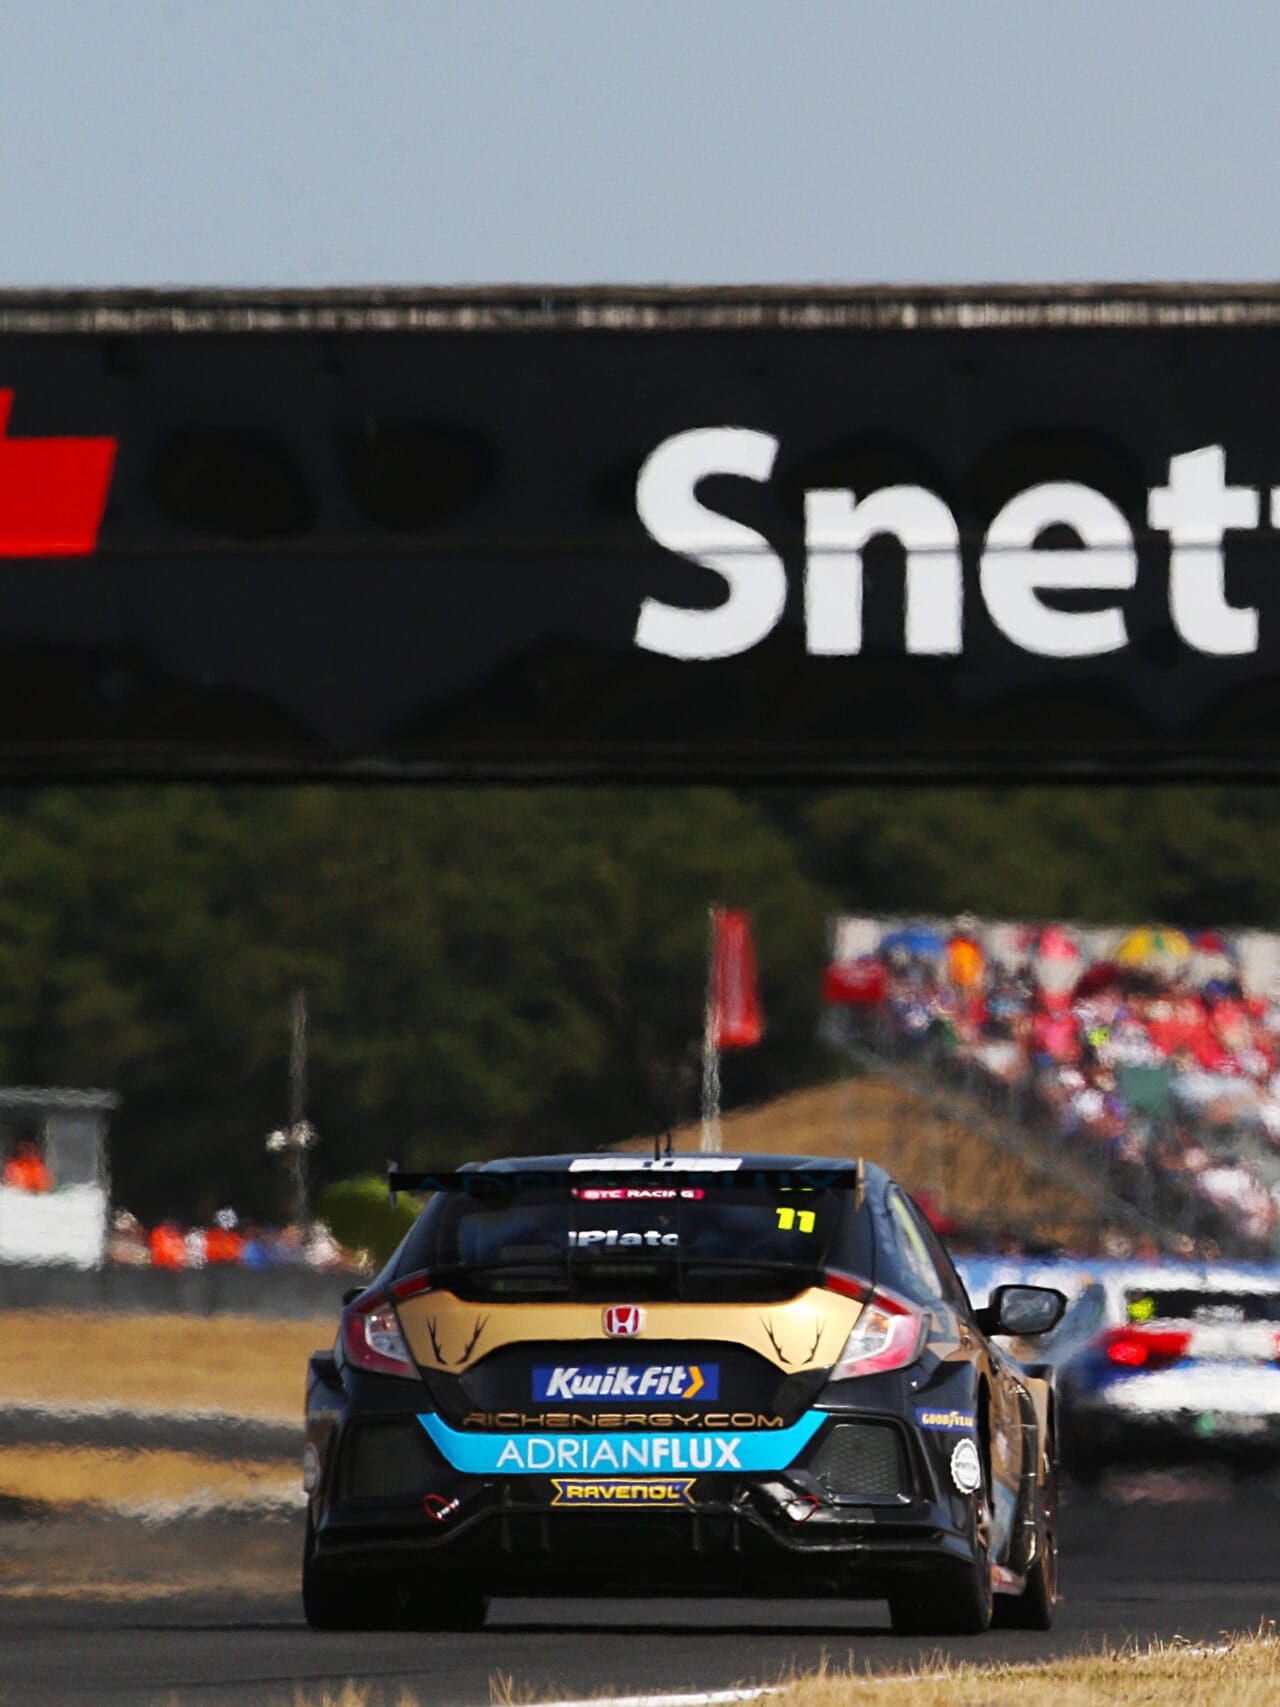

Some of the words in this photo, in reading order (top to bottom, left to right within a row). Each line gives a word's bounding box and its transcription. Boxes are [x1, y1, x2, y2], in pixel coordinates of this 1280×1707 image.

[776, 1207, 816, 1234] 11
[463, 1412, 784, 1428] RICHENERGY.COM
[496, 1437, 742, 1469] ADRIANFLUX
[566, 1484, 681, 1499] RAVENOL
